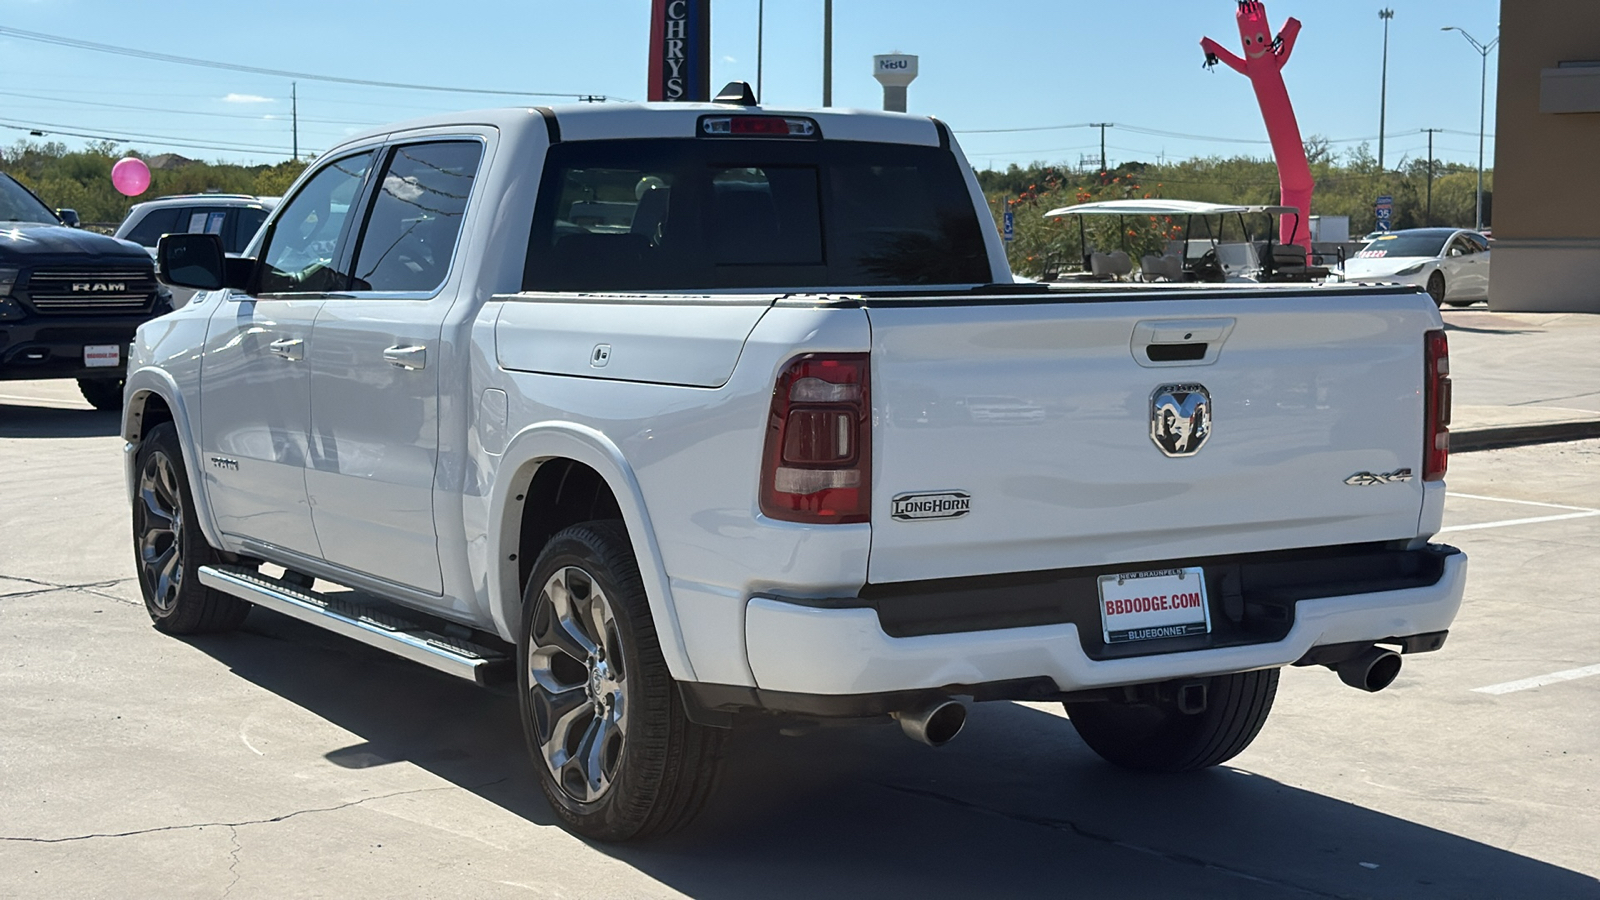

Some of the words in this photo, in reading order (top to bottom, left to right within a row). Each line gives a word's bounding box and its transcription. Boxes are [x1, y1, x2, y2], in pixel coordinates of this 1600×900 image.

[665, 1, 686, 101] CHRYS
[880, 60, 907, 69] NBU
[1377, 209, 1389, 218] 35
[72, 283, 125, 291] RAM
[1138, 569, 1182, 578] BRAUNFELS
[1105, 592, 1201, 616] BBDODGE.COM
[1127, 625, 1187, 640] BLUEBONNET
